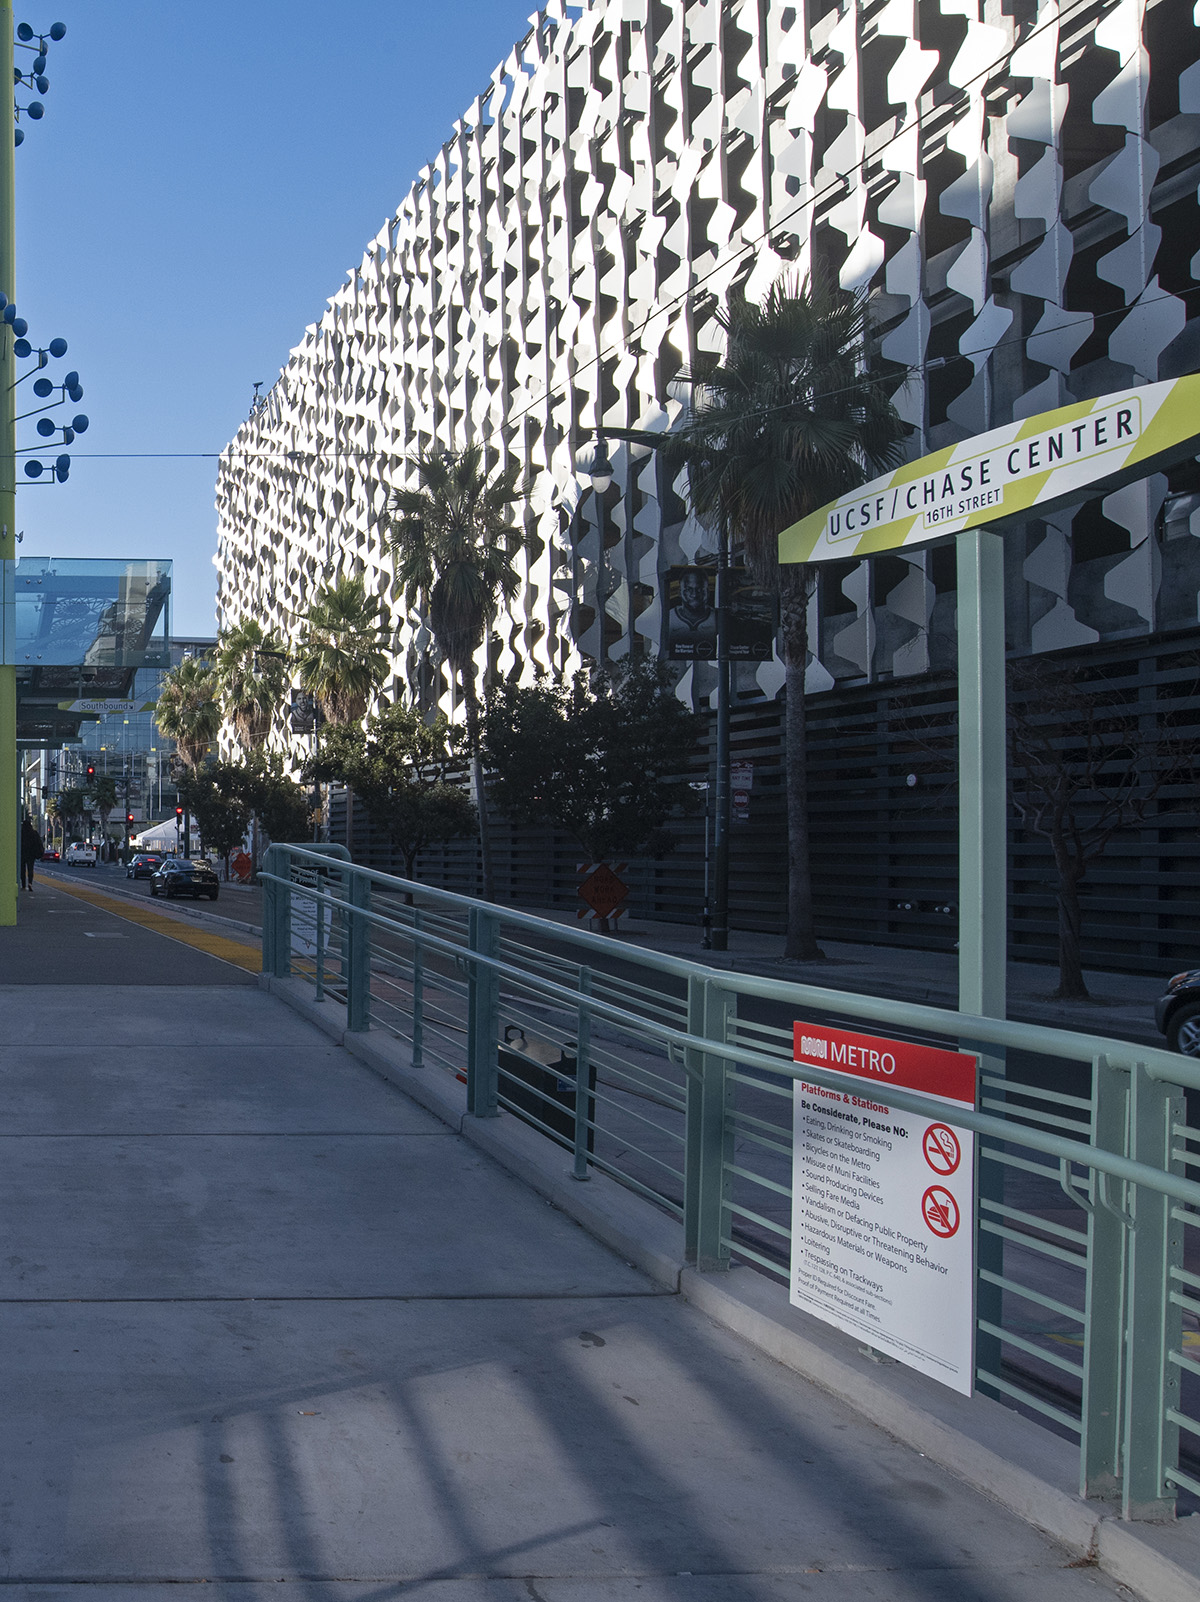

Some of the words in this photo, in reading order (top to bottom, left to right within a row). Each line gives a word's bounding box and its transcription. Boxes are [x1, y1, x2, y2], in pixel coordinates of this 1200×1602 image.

[830, 459, 991, 536] UCSF/CHASE
[1007, 409, 1133, 475] CENTER
[926, 504, 953, 524] 16TH
[958, 488, 1000, 514] STREET
[81, 702, 128, 710] Southbound
[831, 1041, 897, 1075] METRO
[801, 1082, 841, 1102] Platforms
[843, 1093, 850, 1104] &
[851, 1096, 890, 1115] Stations
[801, 1100, 811, 1109] Be
[812, 1103, 862, 1126] Considerate,
[862, 1117, 892, 1133] Please
[893, 1126, 909, 1139] NO:
[806, 1116, 827, 1130] Eating,
[827, 1122, 854, 1139] Drinking
[862, 1132, 893, 1151] Smoking
[805, 1142, 829, 1157] Bicycles
[839, 1154, 850, 1164] the
[851, 1158, 871, 1171] Metro
[806, 1129, 825, 1142] Skates
[834, 1138, 881, 1161] Skateboarding
[805, 1156, 826, 1170] Misuse
[826, 1164, 834, 1172] of
[834, 1164, 851, 1178] Muni
[852, 1171, 880, 1189] Facilities
[805, 1169, 825, 1183] Sound
[825, 1175, 857, 1197] Producing
[858, 1188, 884, 1205] Devices
[805, 1182, 825, 1198] Selling
[825, 1190, 840, 1203] Fare
[840, 1196, 860, 1210] Media
[805, 1195, 836, 1215] Vandalism
[845, 1211, 874, 1232] Defacing
[874, 1222, 896, 1239] Public
[897, 1231, 929, 1253] Property
[804, 1209, 830, 1227] Abusive,
[830, 1219, 863, 1240] Disruptive
[863, 1234, 871, 1242] or
[872, 1235, 915, 1263] Threatening
[915, 1254, 949, 1275] Behavior
[804, 1235, 831, 1255] Loitering
[804, 1222, 836, 1242] Hazardous
[836, 1236, 865, 1256] Materials
[866, 1250, 874, 1258] or
[875, 1252, 908, 1274] Weapons
[804, 1249, 839, 1273] Trespassing
[839, 1267, 848, 1276] on
[849, 1268, 884, 1293] Trackways
[818, 1277, 837, 1291] Required
[844, 1289, 864, 1305] Discount
